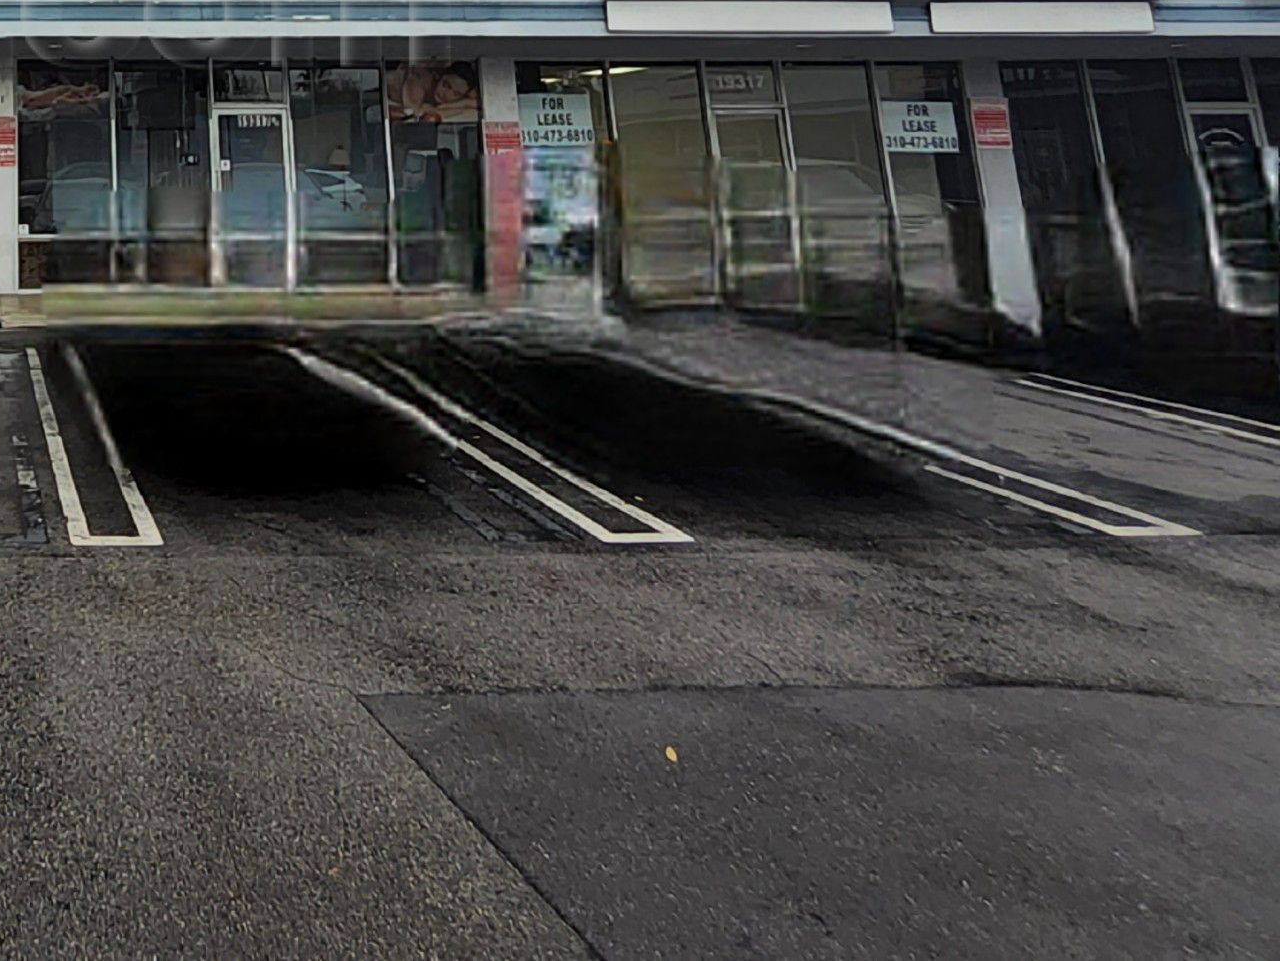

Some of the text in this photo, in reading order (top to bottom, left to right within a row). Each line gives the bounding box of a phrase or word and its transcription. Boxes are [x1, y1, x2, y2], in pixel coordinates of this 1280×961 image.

[541, 98, 565, 110] FOR
[906, 104, 929, 117] FOR
[536, 113, 574, 127] LEASE
[902, 120, 938, 133] LEASE
[885, 136, 958, 149] 310-473-6810
